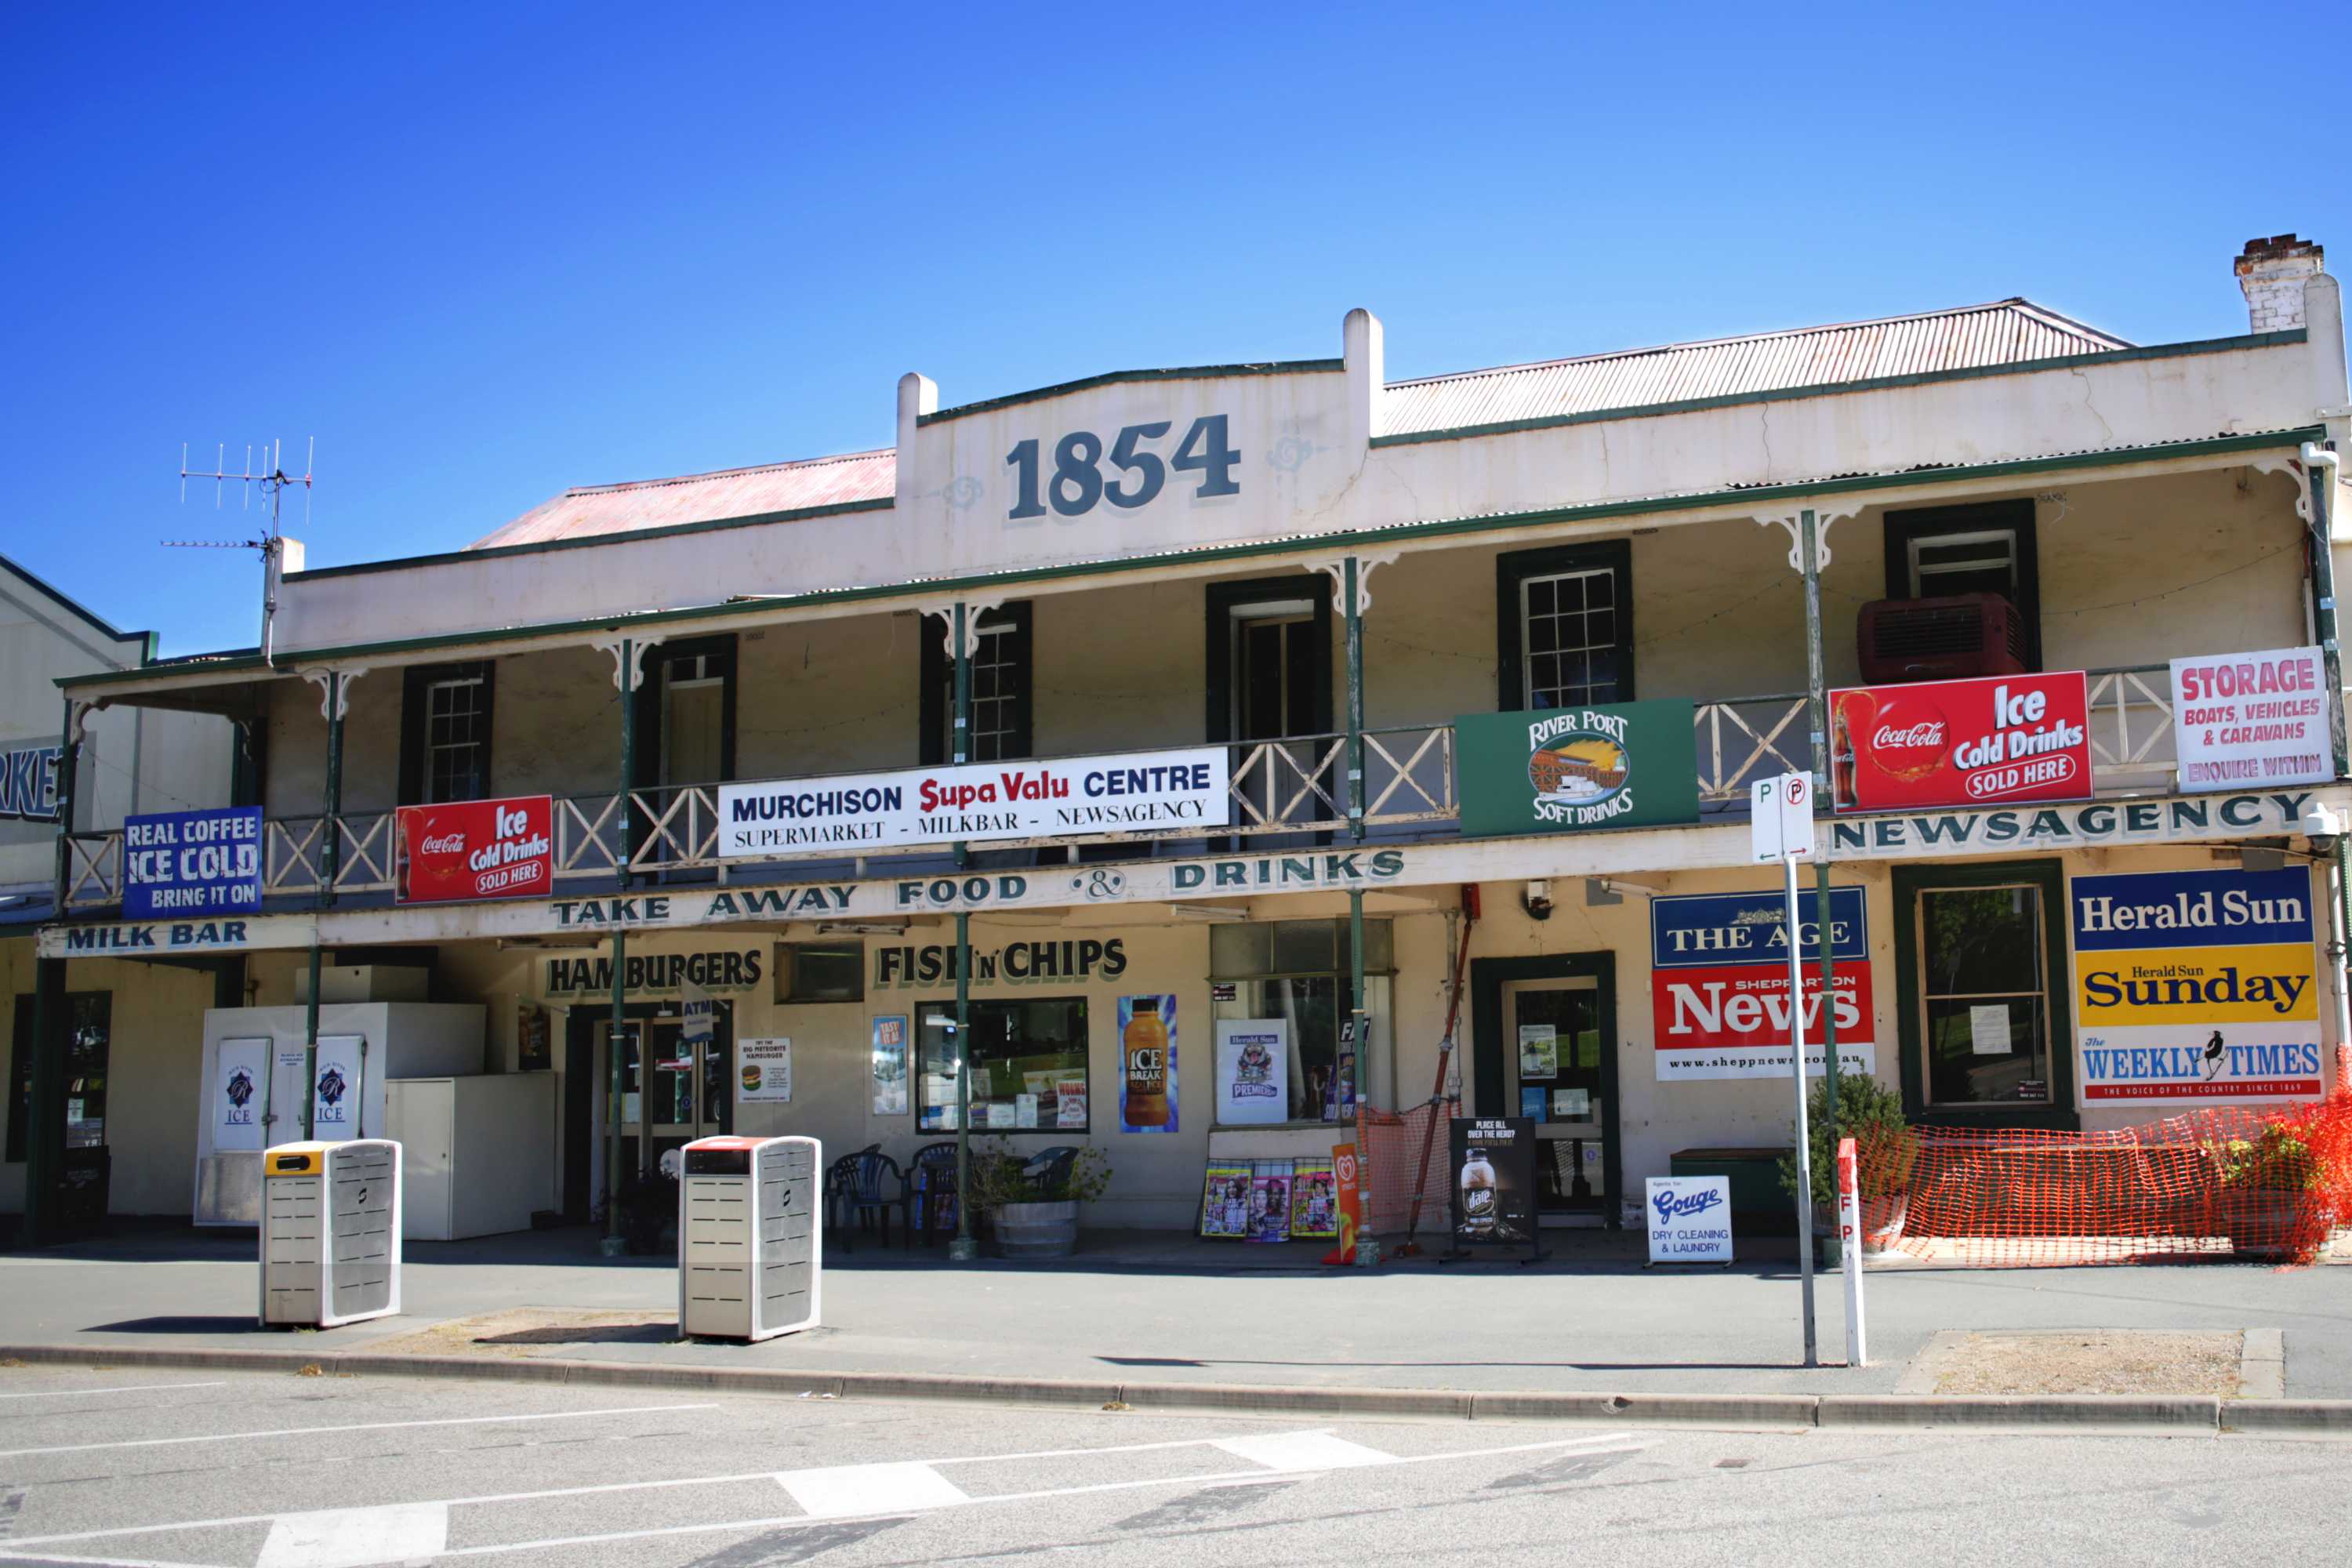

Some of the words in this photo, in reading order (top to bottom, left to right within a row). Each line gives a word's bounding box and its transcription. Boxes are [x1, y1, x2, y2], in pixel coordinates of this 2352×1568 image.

[1006, 414, 1240, 520] 1854
[2181, 659, 2315, 701] STORAGE
[1994, 685, 2045, 730] Ice
[2184, 705, 2238, 725] BOATS,
[2245, 699, 2320, 720] VEHICLES
[1529, 713, 1577, 751] RIVER
[1583, 710, 1628, 743] PORT
[1955, 732, 2005, 770] Cold
[2010, 719, 2083, 759] Drinks
[2203, 729, 2215, 746] &
[2220, 722, 2305, 744] CARAVANS
[1973, 769, 2018, 795] SOLD
[2024, 758, 2067, 785] HERE
[2187, 757, 2258, 782] ENQUIRE
[2263, 753, 2322, 776] WITHIN
[733, 786, 902, 822] MURCHISON
[920, 779, 997, 812] Supa
[1001, 770, 1069, 802] Valu
[1083, 764, 1210, 797] CENTRE
[1534, 797, 1573, 824] SOFT
[1577, 788, 1633, 824] DRINKS
[1761, 783, 1771, 803] P
[127, 824, 178, 847] REAL
[183, 817, 256, 844] COFFEE
[496, 805, 526, 840] Ice
[735, 821, 884, 848] SUPERMARKET
[918, 813, 1018, 836] MILKBAR
[1056, 799, 1207, 826] NEWSAGENCY
[1832, 792, 2314, 849] NEWSAGENCY
[129, 849, 173, 884] ICE
[180, 844, 258, 880] COLD
[470, 846, 501, 872] Cold
[503, 833, 549, 864] Drinks
[480, 873, 508, 893] SOLD
[510, 865, 539, 884] HERE
[553, 896, 670, 924] TAKE
[707, 885, 858, 916] AWAY
[898, 876, 1027, 905] FOOD
[1176, 850, 1404, 888] DRINKS
[151, 886, 205, 908] BRING
[211, 885, 227, 905] IT
[231, 884, 256, 904] ON
[2079, 891, 2217, 932] Herald
[2223, 890, 2305, 925] Sun
[67, 924, 156, 949] MILK
[171, 921, 247, 946] BAR
[1667, 927, 1753, 951] THE
[1765, 921, 1850, 947] AGE
[550, 950, 761, 991] HAMBURGERS
[880, 944, 973, 982] FISH
[1004, 938, 1127, 978] CHIPS
[2132, 965, 2176, 978] Herald
[2178, 965, 2204, 977] Sun
[2085, 967, 2310, 1013] Sunday
[684, 1000, 710, 1016] ATM
[1667, 982, 1860, 1034] News
[2085, 1037, 2105, 1047] The
[1129, 1048, 1162, 1070] ICE
[2083, 1047, 2203, 1080] WEEKLY
[2225, 1043, 2319, 1076] TIMES
[1130, 1070, 1161, 1080] BREAK
[2126, 1086, 2154, 1095] VOICE
[2159, 1085, 2171, 1094] OF
[2176, 1084, 2193, 1094] THE
[2198, 1083, 2240, 1093] COUNTRY
[2247, 1083, 2274, 1092] SINCE
[2280, 1083, 2301, 1091] 1869
[227, 1110, 250, 1122] ICE
[318, 1108, 343, 1120] ICE
[1476, 1120, 1494, 1129] PLACE
[1495, 1120, 1505, 1129] ALL
[1468, 1130, 1483, 1138] OVER
[1484, 1130, 1494, 1138] THE
[1468, 1191, 1490, 1209] dare
[1653, 1189, 1722, 1225] Gouge
[1841, 1196, 1851, 1212] F
[1653, 1231, 1672, 1240] DRY
[1677, 1229, 1729, 1240] CLEANING
[1842, 1225, 1853, 1240] P
[1662, 1243, 1668, 1253] &
[1673, 1243, 1720, 1253] LAUNDRY
